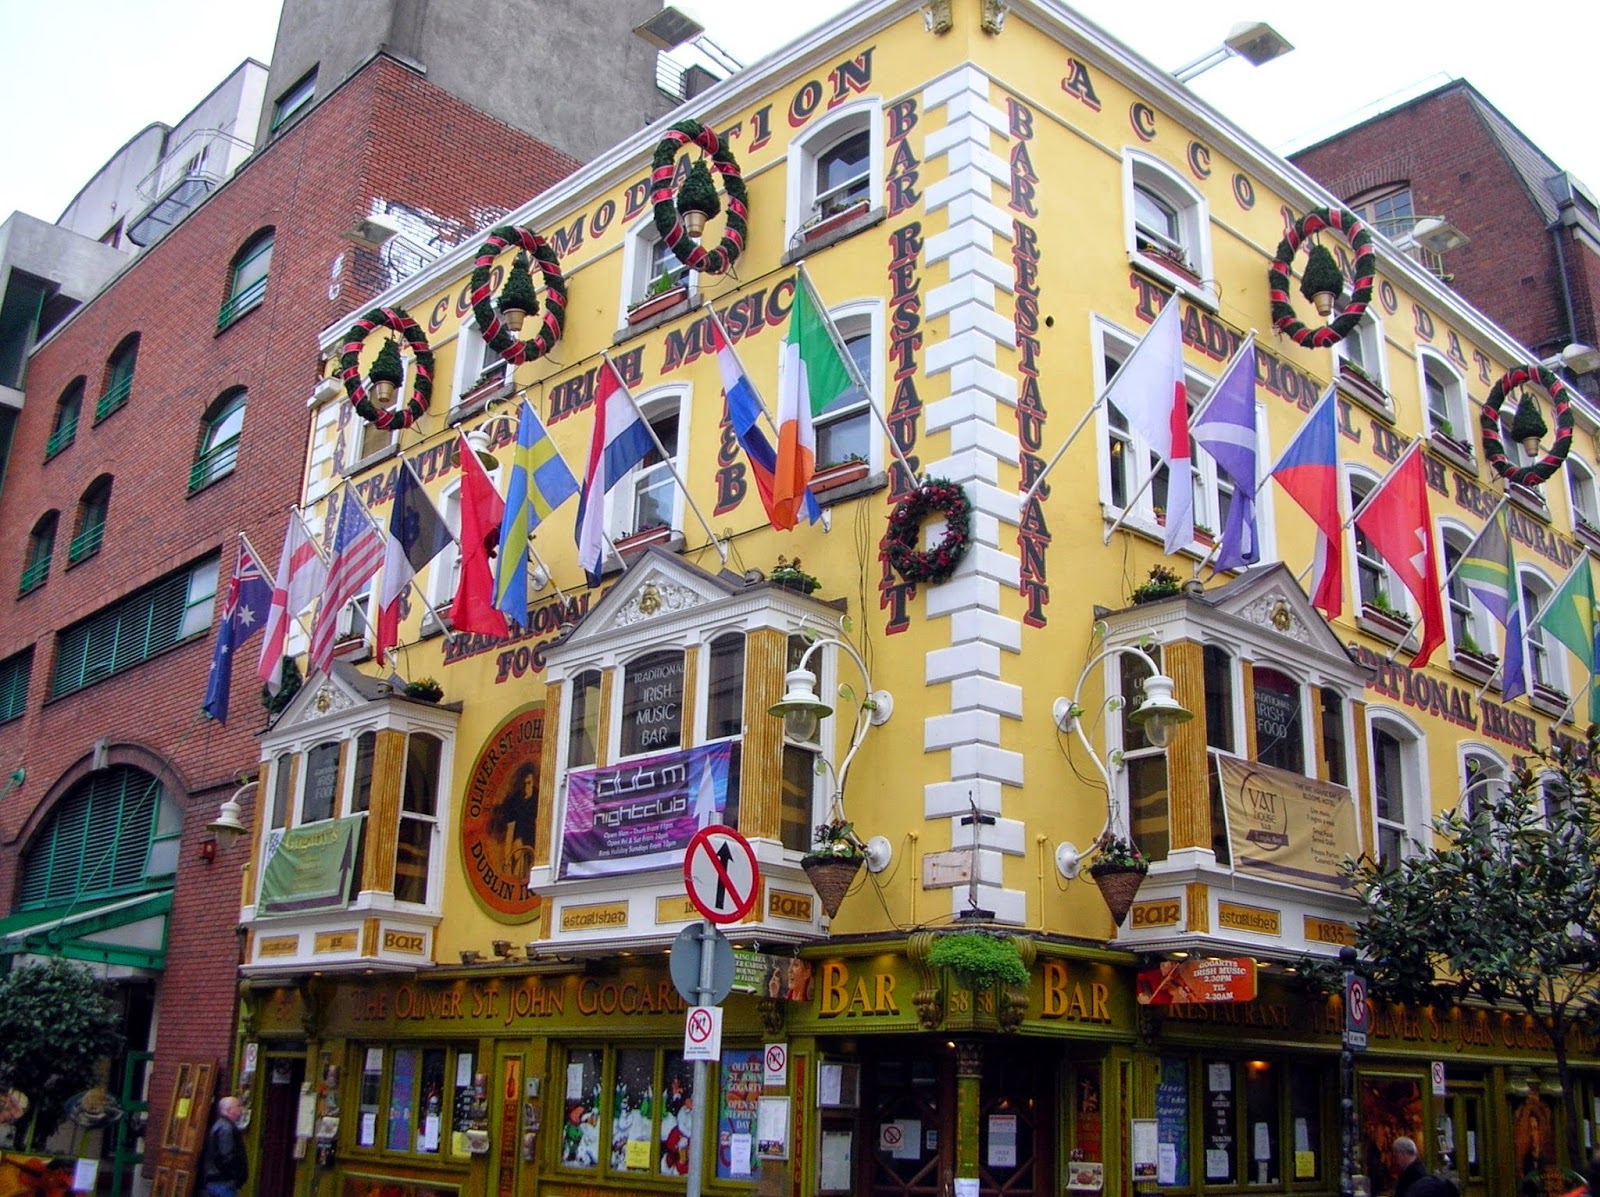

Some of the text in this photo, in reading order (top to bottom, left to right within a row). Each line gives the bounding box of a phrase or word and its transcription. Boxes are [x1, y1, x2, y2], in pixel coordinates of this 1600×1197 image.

[879, 98, 924, 636] BAR RESTAURT
[1006, 97, 1053, 628] BAR RESTAURANT
[356, 410, 518, 509] TRAITIA
[547, 344, 646, 426] IRIH
[1130, 272, 1582, 569] TADIIONL IRH RESAURAN
[495, 638, 560, 684] FOO
[634, 664, 685, 684] TRADITIONAL
[643, 683, 673, 703] IRISH
[636, 703, 676, 725] MUSIC
[1256, 702, 1285, 723] IRISH
[641, 726, 668, 746] BAR
[1258, 718, 1288, 738] FOOD
[470, 748, 501, 818] OLIVER
[1248, 788, 1277, 813] VAT
[593, 797, 687, 826] nightclub
[471, 840, 516, 901] DUBLIN
[1317, 923, 1346, 944] 1835
[1193, 966, 1247, 977] IRISH MUSIC
[1203, 975, 1233, 983] 2.30PM
[1205, 992, 1234, 1001] 2.30AM
[1212, 984, 1226, 992] TIL
[394, 985, 464, 1019] OLIVER
[504, 986, 565, 1027] JOHN
[577, 976, 686, 1016] GOGAR
[950, 990, 969, 1013] 58
[731, 1062, 760, 1072] OLIVER
[728, 1082, 762, 1092] GOGARTY
